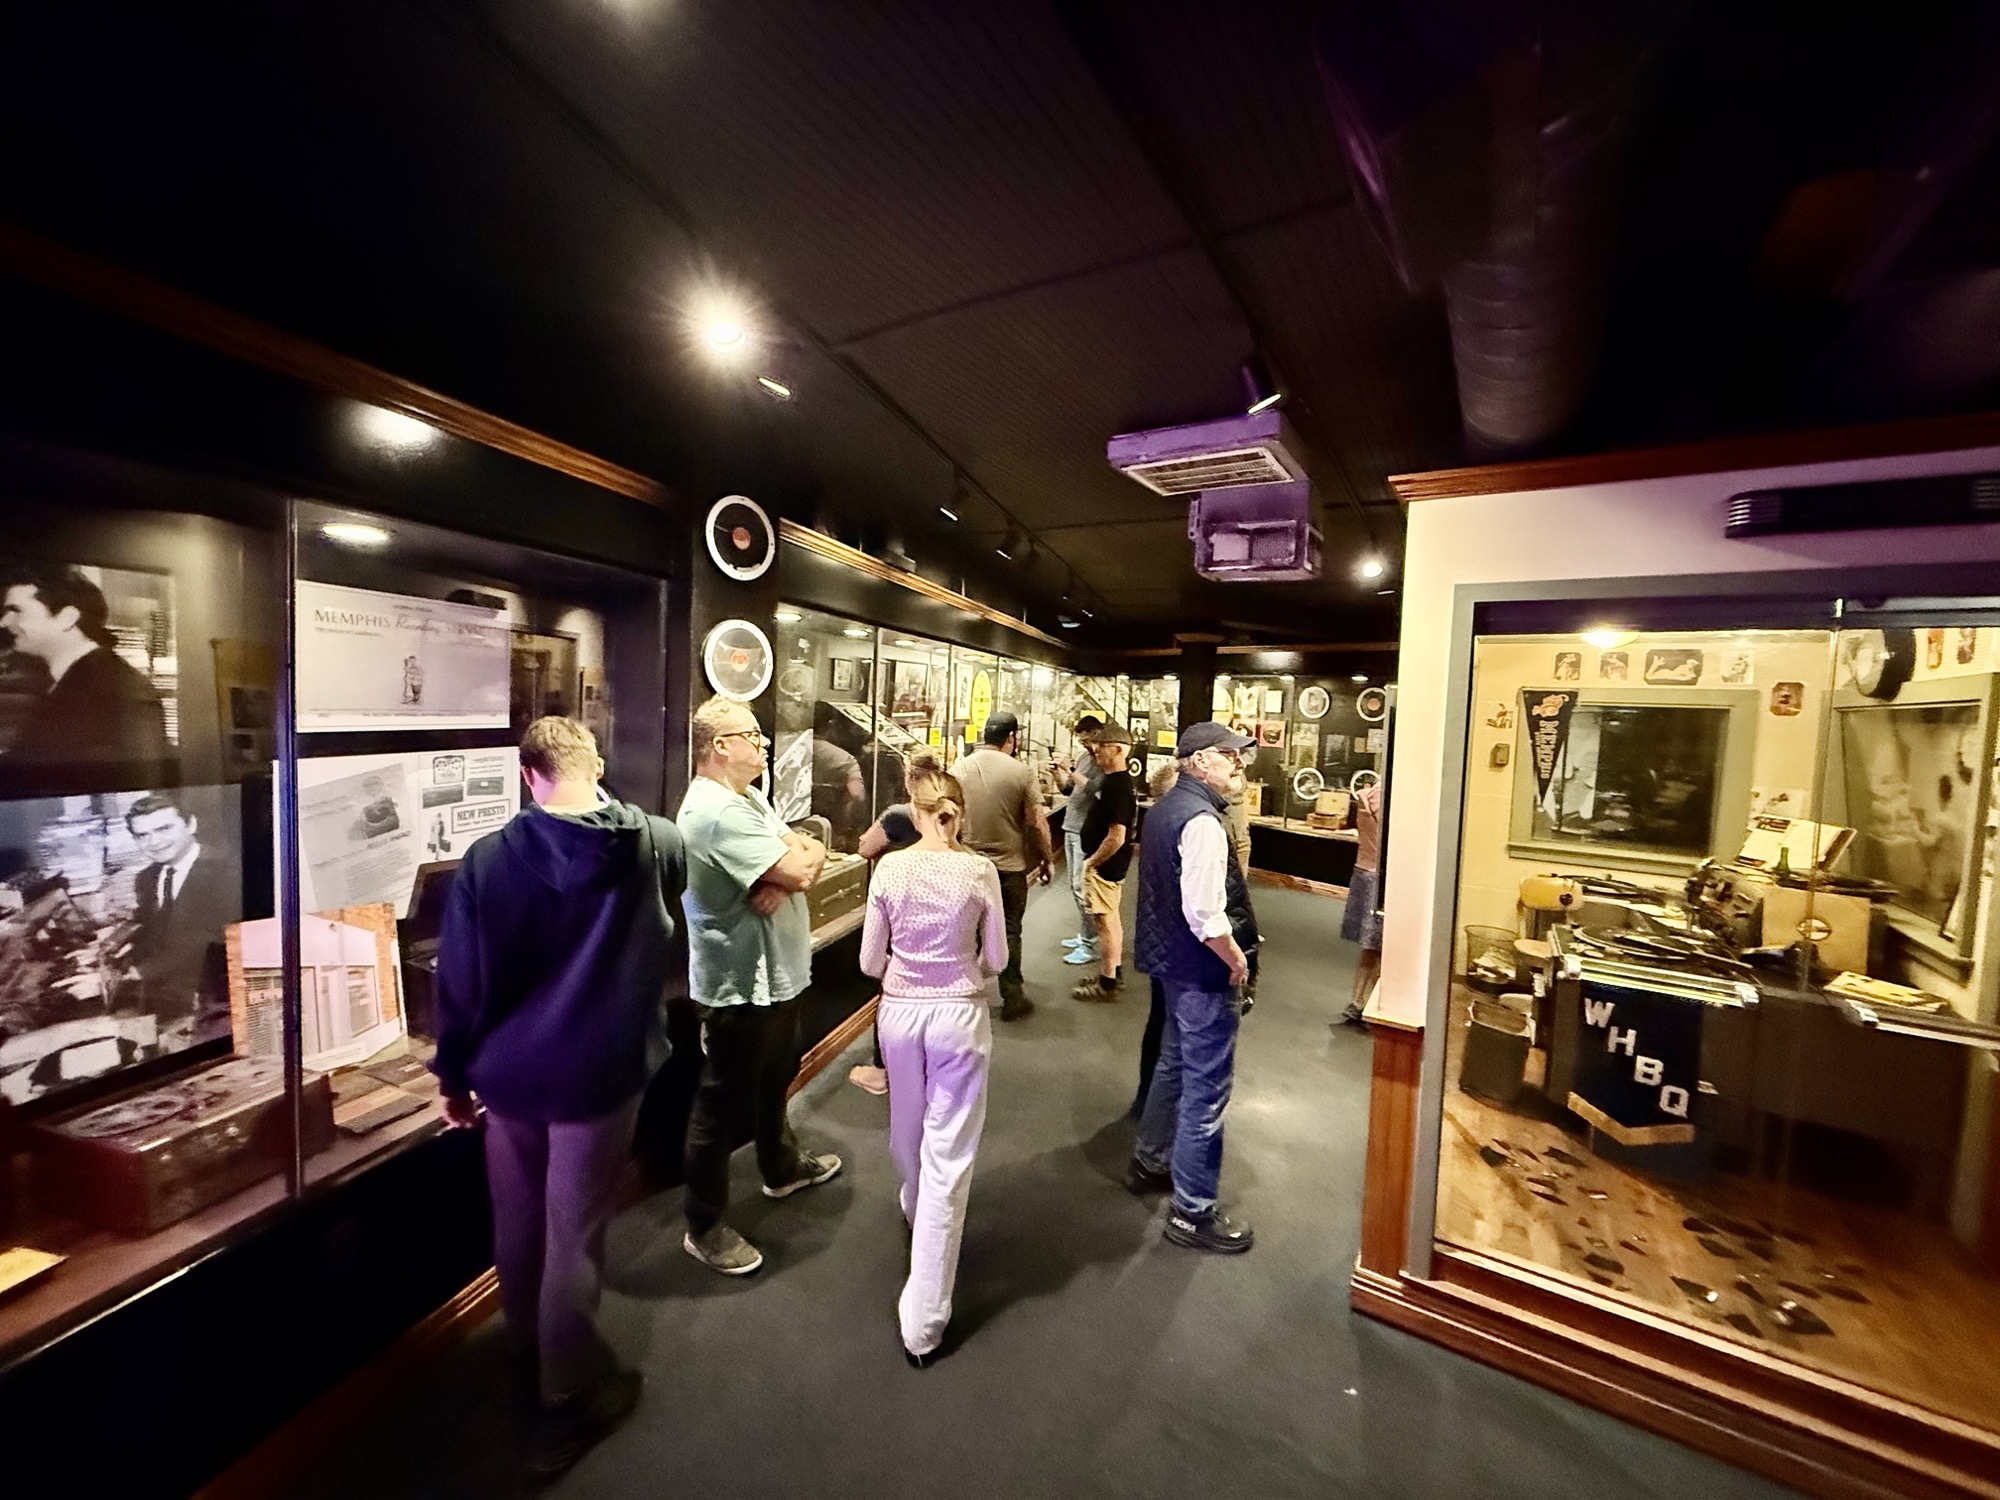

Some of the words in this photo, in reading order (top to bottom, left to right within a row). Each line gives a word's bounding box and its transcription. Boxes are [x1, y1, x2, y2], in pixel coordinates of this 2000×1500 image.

[315, 609, 391, 629] MEMPHIS
[457, 809, 476, 822] NEW
[477, 805, 506, 818] PRESTO
[1584, 997, 1690, 1119] WHBQ
